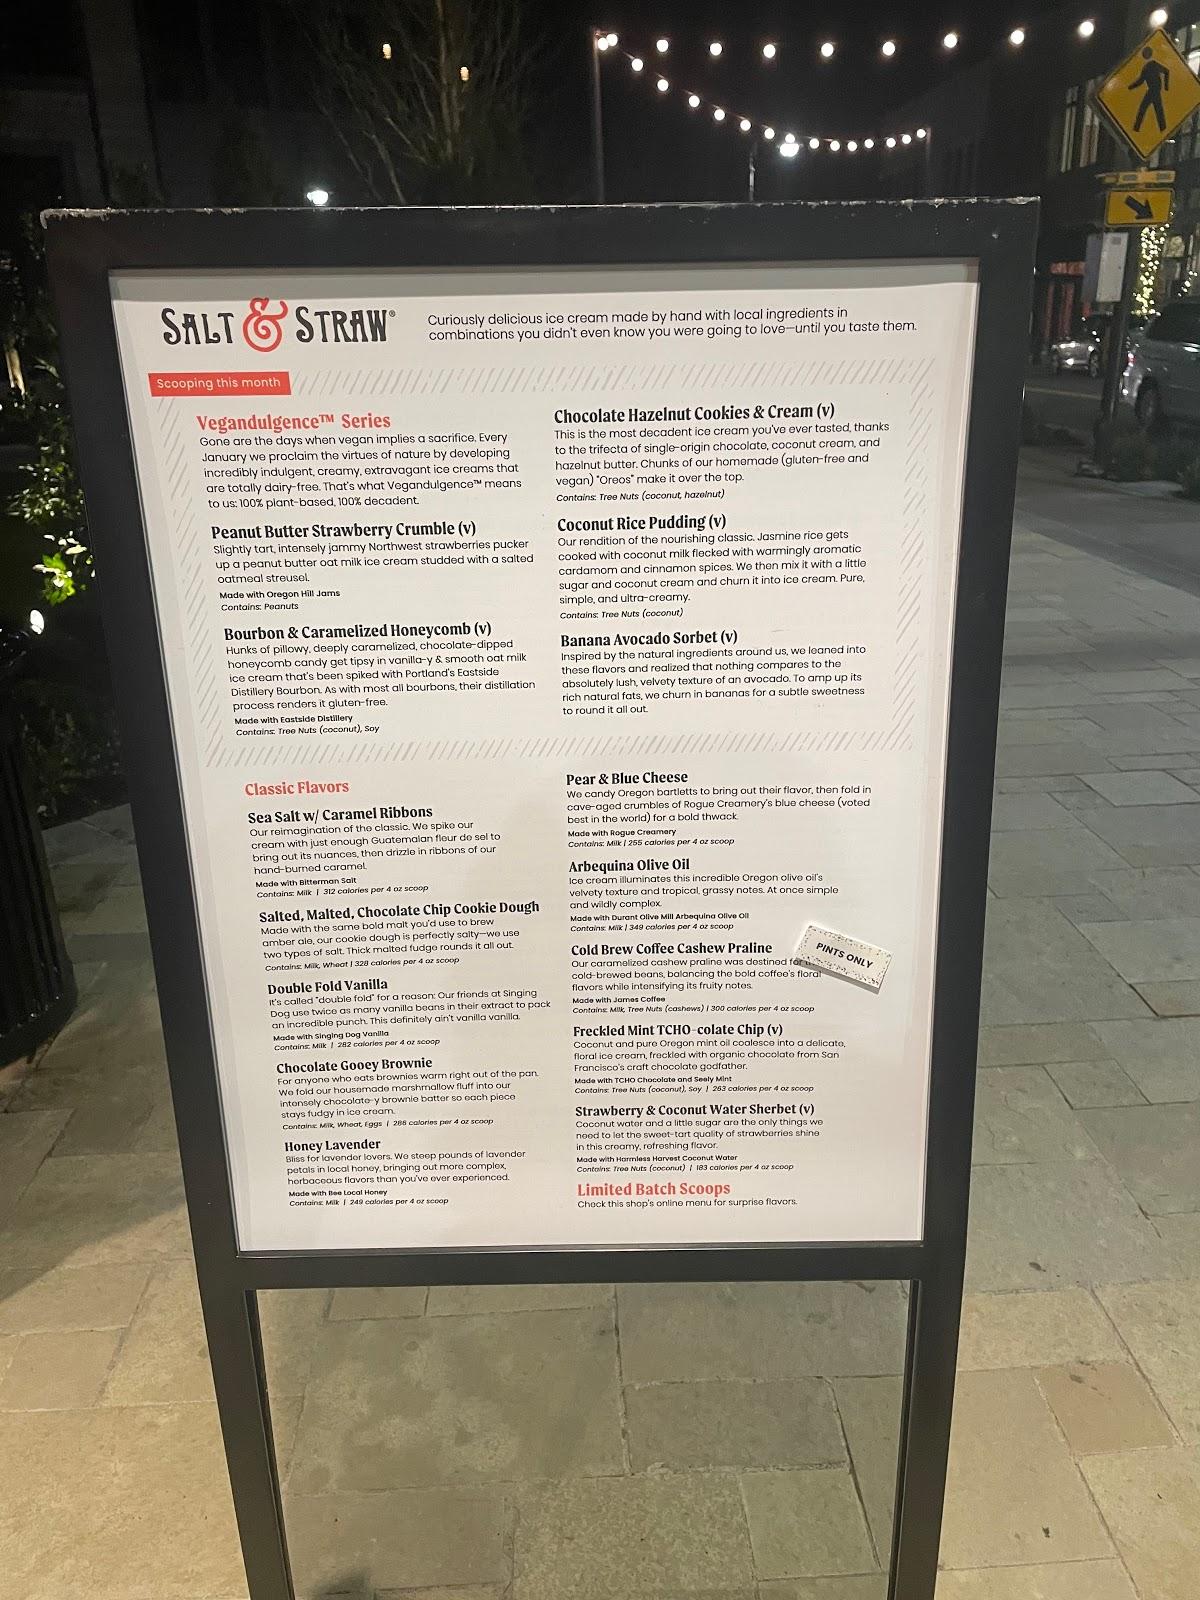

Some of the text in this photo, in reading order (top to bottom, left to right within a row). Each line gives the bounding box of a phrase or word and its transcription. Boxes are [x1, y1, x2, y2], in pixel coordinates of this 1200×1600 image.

[243, 297, 288, 352] &
[428, 306, 848, 328] Curiously delicious ice cream made by hand with local ingredients in
[428, 328, 514, 341] combinations
[516, 330, 540, 341] you
[543, 326, 578, 339] didn't
[580, 328, 610, 338] even
[613, 326, 646, 338] know
[648, 327, 671, 339] you
[673, 327, 704, 336] were
[706, 326, 742, 338] going
[744, 324, 758, 335] to
[823, 323, 846, 336] you
[848, 321, 880, 332] taste
[883, 320, 917, 331] them.
[156, 377, 281, 391] Scooping this month
[341, 412, 391, 429] Series
[554, 402, 835, 424] Chocolate Hazelnut Cookies & Cream (v)
[199, 432, 508, 448] Gone are the days when vegan implies a sacrifice. Every
[208, 495, 420, 510] to us: 100% plant-based, 100% decadent.
[556, 493, 597, 502] Contains:
[599, 493, 618, 501] Tree
[619, 493, 640, 501] Nuts
[684, 488, 725, 499] hazelnut)
[211, 520, 476, 540] Peanut Butter Strawberry Crumble (v)
[557, 513, 726, 532] Coconut Rice Pudding (v)
[219, 591, 245, 599] Made
[245, 590, 265, 599] with
[266, 590, 299, 600] Oregon
[300, 589, 314, 598] Hill
[221, 602, 299, 611] Contains: Peanuts
[224, 621, 492, 641] Bourbon & Caramelized Honeycomb (v)
[561, 629, 738, 647] Banana Avocado Sorbet (v)
[566, 771, 688, 786] Pear & Blue Cheese
[245, 780, 349, 796] Classic Flavors
[248, 806, 433, 825] Sea Salt w/ Caramel Ribbons
[591, 829, 609, 837] with
[610, 829, 635, 838] Rogue
[636, 829, 677, 837] Creamery
[568, 858, 690, 875] Arbequina Olive Oil
[259, 900, 539, 923] Salted, Malted, Chocolate Chip Cookie Dough
[571, 942, 773, 956] Cold Brew Coffee Cashew Praline
[816, 942, 874, 968] PINTS ONLY
[267, 978, 388, 995] Double Fold Vanilla
[314, 1032, 344, 1041] Singing
[345, 1032, 361, 1040] Dog
[573, 1024, 625, 1037] Freckled
[627, 1024, 655, 1036] Mint
[737, 1023, 764, 1038] Chip
[767, 1023, 783, 1037] (v)
[276, 1057, 432, 1074] Chocolate Gooey Brownie
[575, 1103, 814, 1118] Strawberry & Coconut Water Sherbet (v)
[284, 1138, 381, 1154] Honey Lavender
[364, 1189, 388, 1197] Honey
[577, 1182, 731, 1198] Limited Batch Scoops
[577, 1200, 606, 1208] Check
[607, 1200, 624, 1208] this
[625, 1198, 654, 1209] shop's
[656, 1199, 683, 1207] online
[713, 1198, 726, 1206] for
[728, 1197, 764, 1208] surprise
[765, 1197, 797, 1206] flavors.
